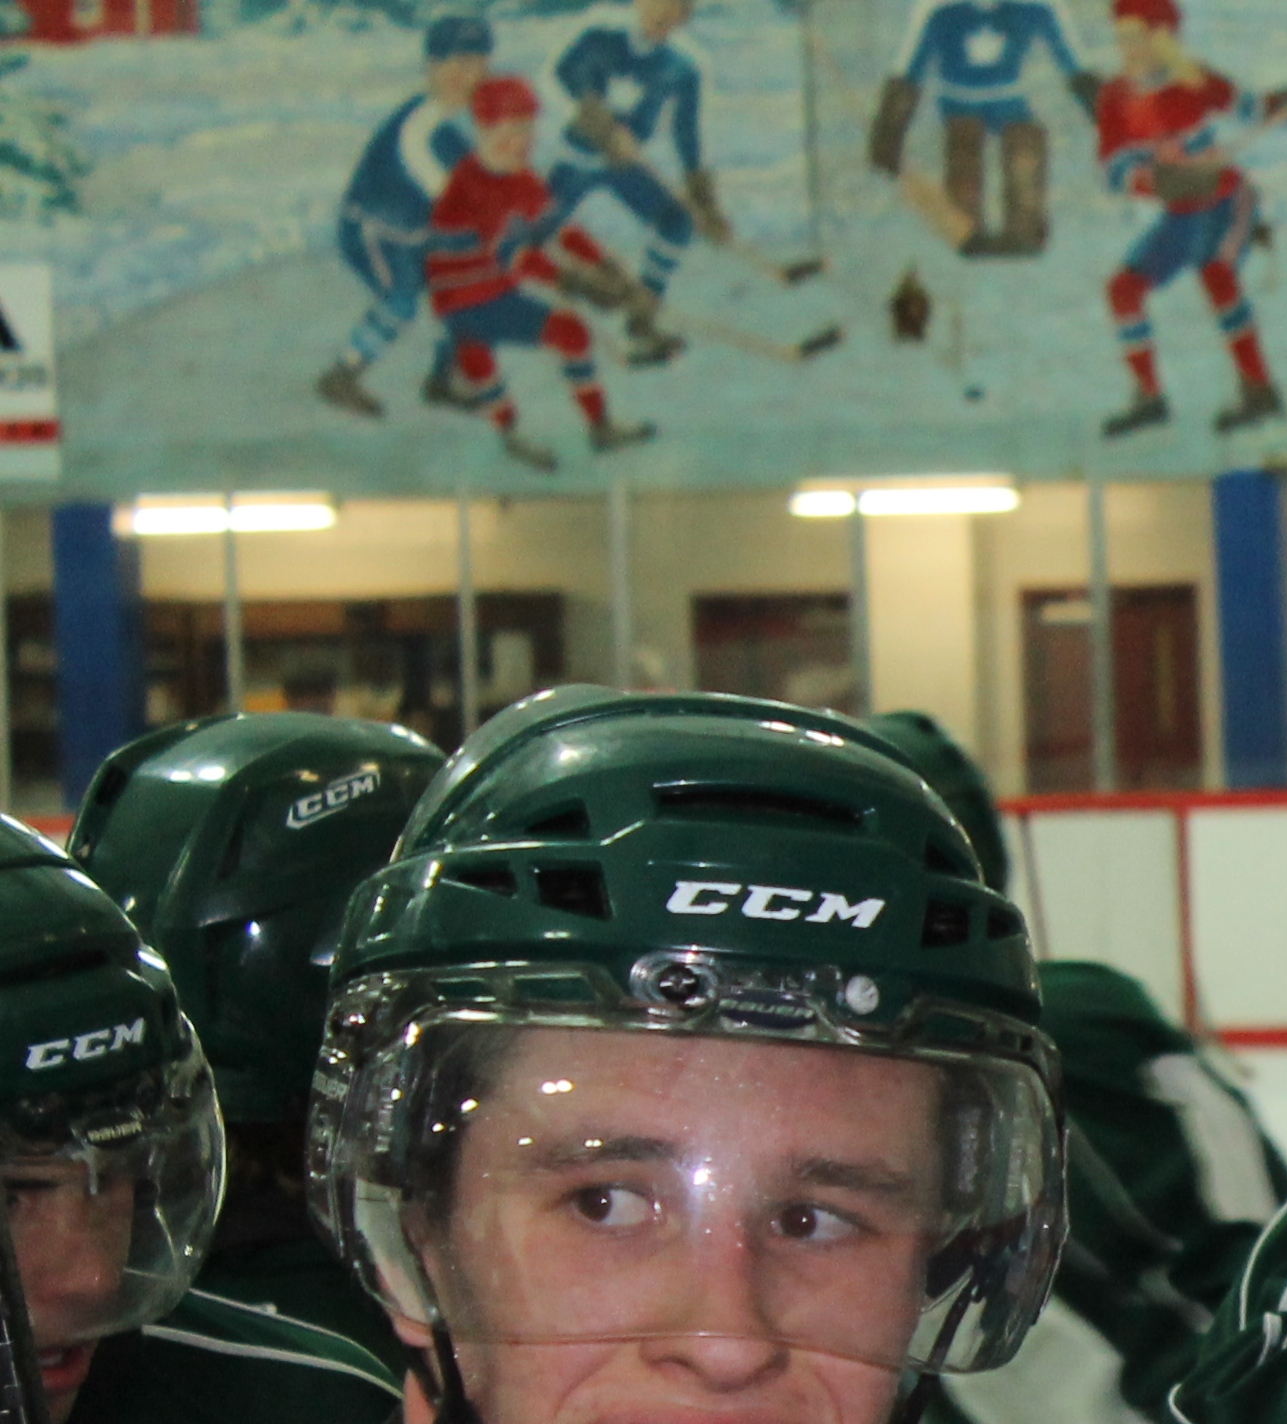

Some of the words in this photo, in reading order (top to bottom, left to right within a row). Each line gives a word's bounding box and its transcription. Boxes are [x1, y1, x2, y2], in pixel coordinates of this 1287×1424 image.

[297, 775, 374, 818] CCM
[666, 880, 885, 929] CCM
[26, 1017, 145, 1070] CCM
